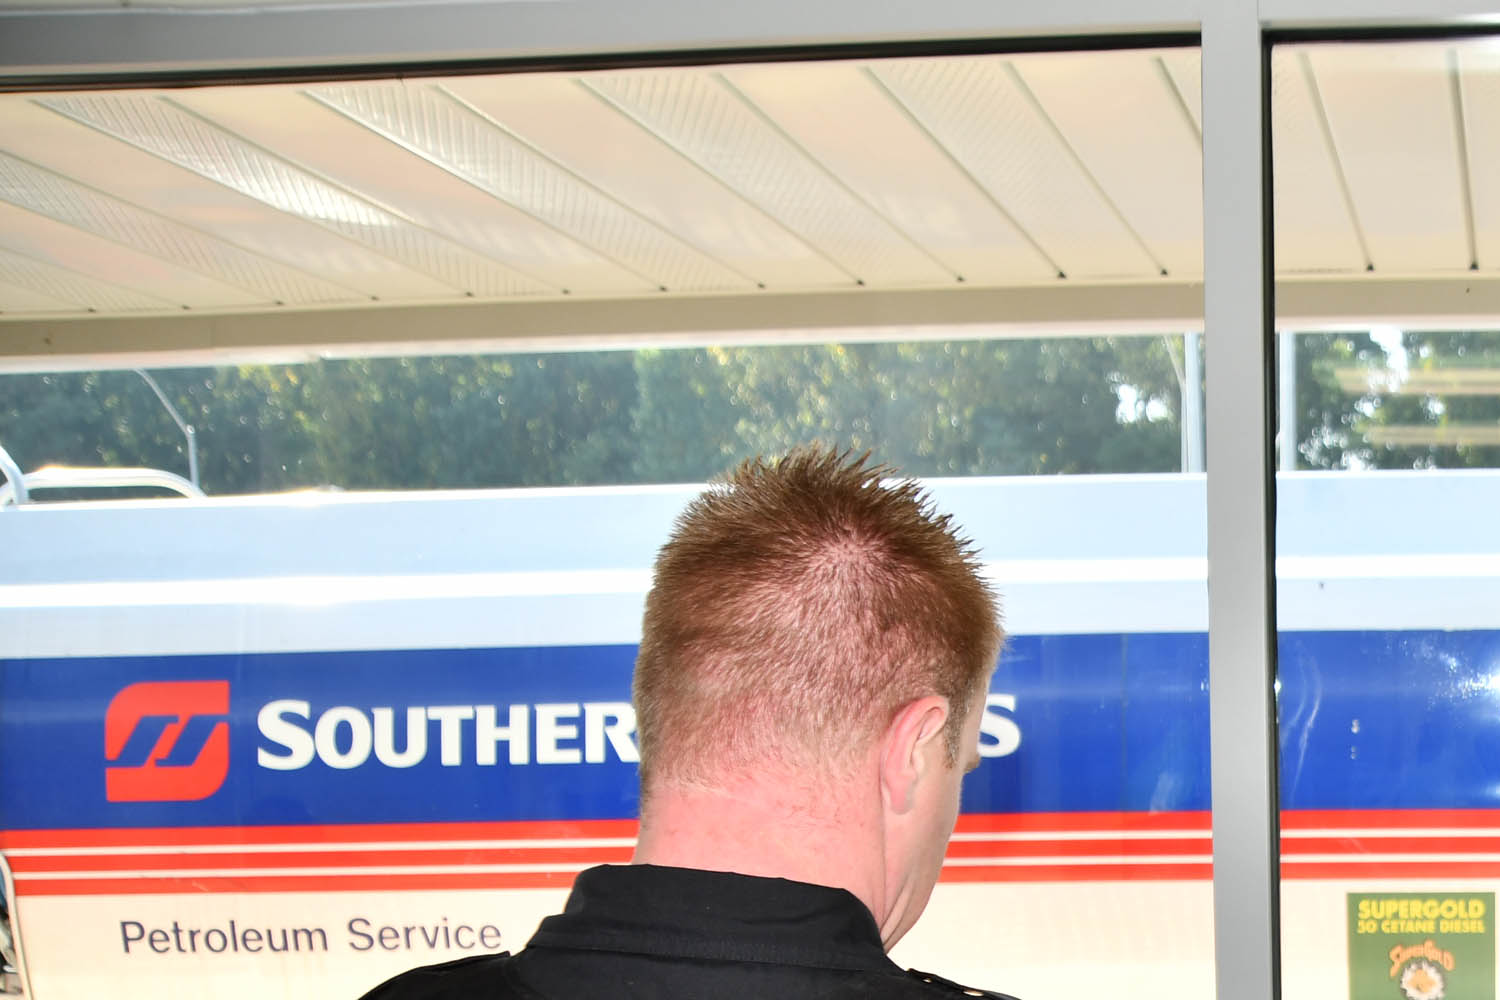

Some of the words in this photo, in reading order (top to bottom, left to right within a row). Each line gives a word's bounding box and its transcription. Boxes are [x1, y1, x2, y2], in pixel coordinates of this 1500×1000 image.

[257, 699, 640, 770] SOUTHER
[1358, 898, 1486, 919] SUPERGOLD
[119, 919, 329, 954] Petroleum
[348, 916, 502, 951] Service
[1381, 919, 1436, 933] CETANE
[1440, 919, 1486, 933] DIESEL
